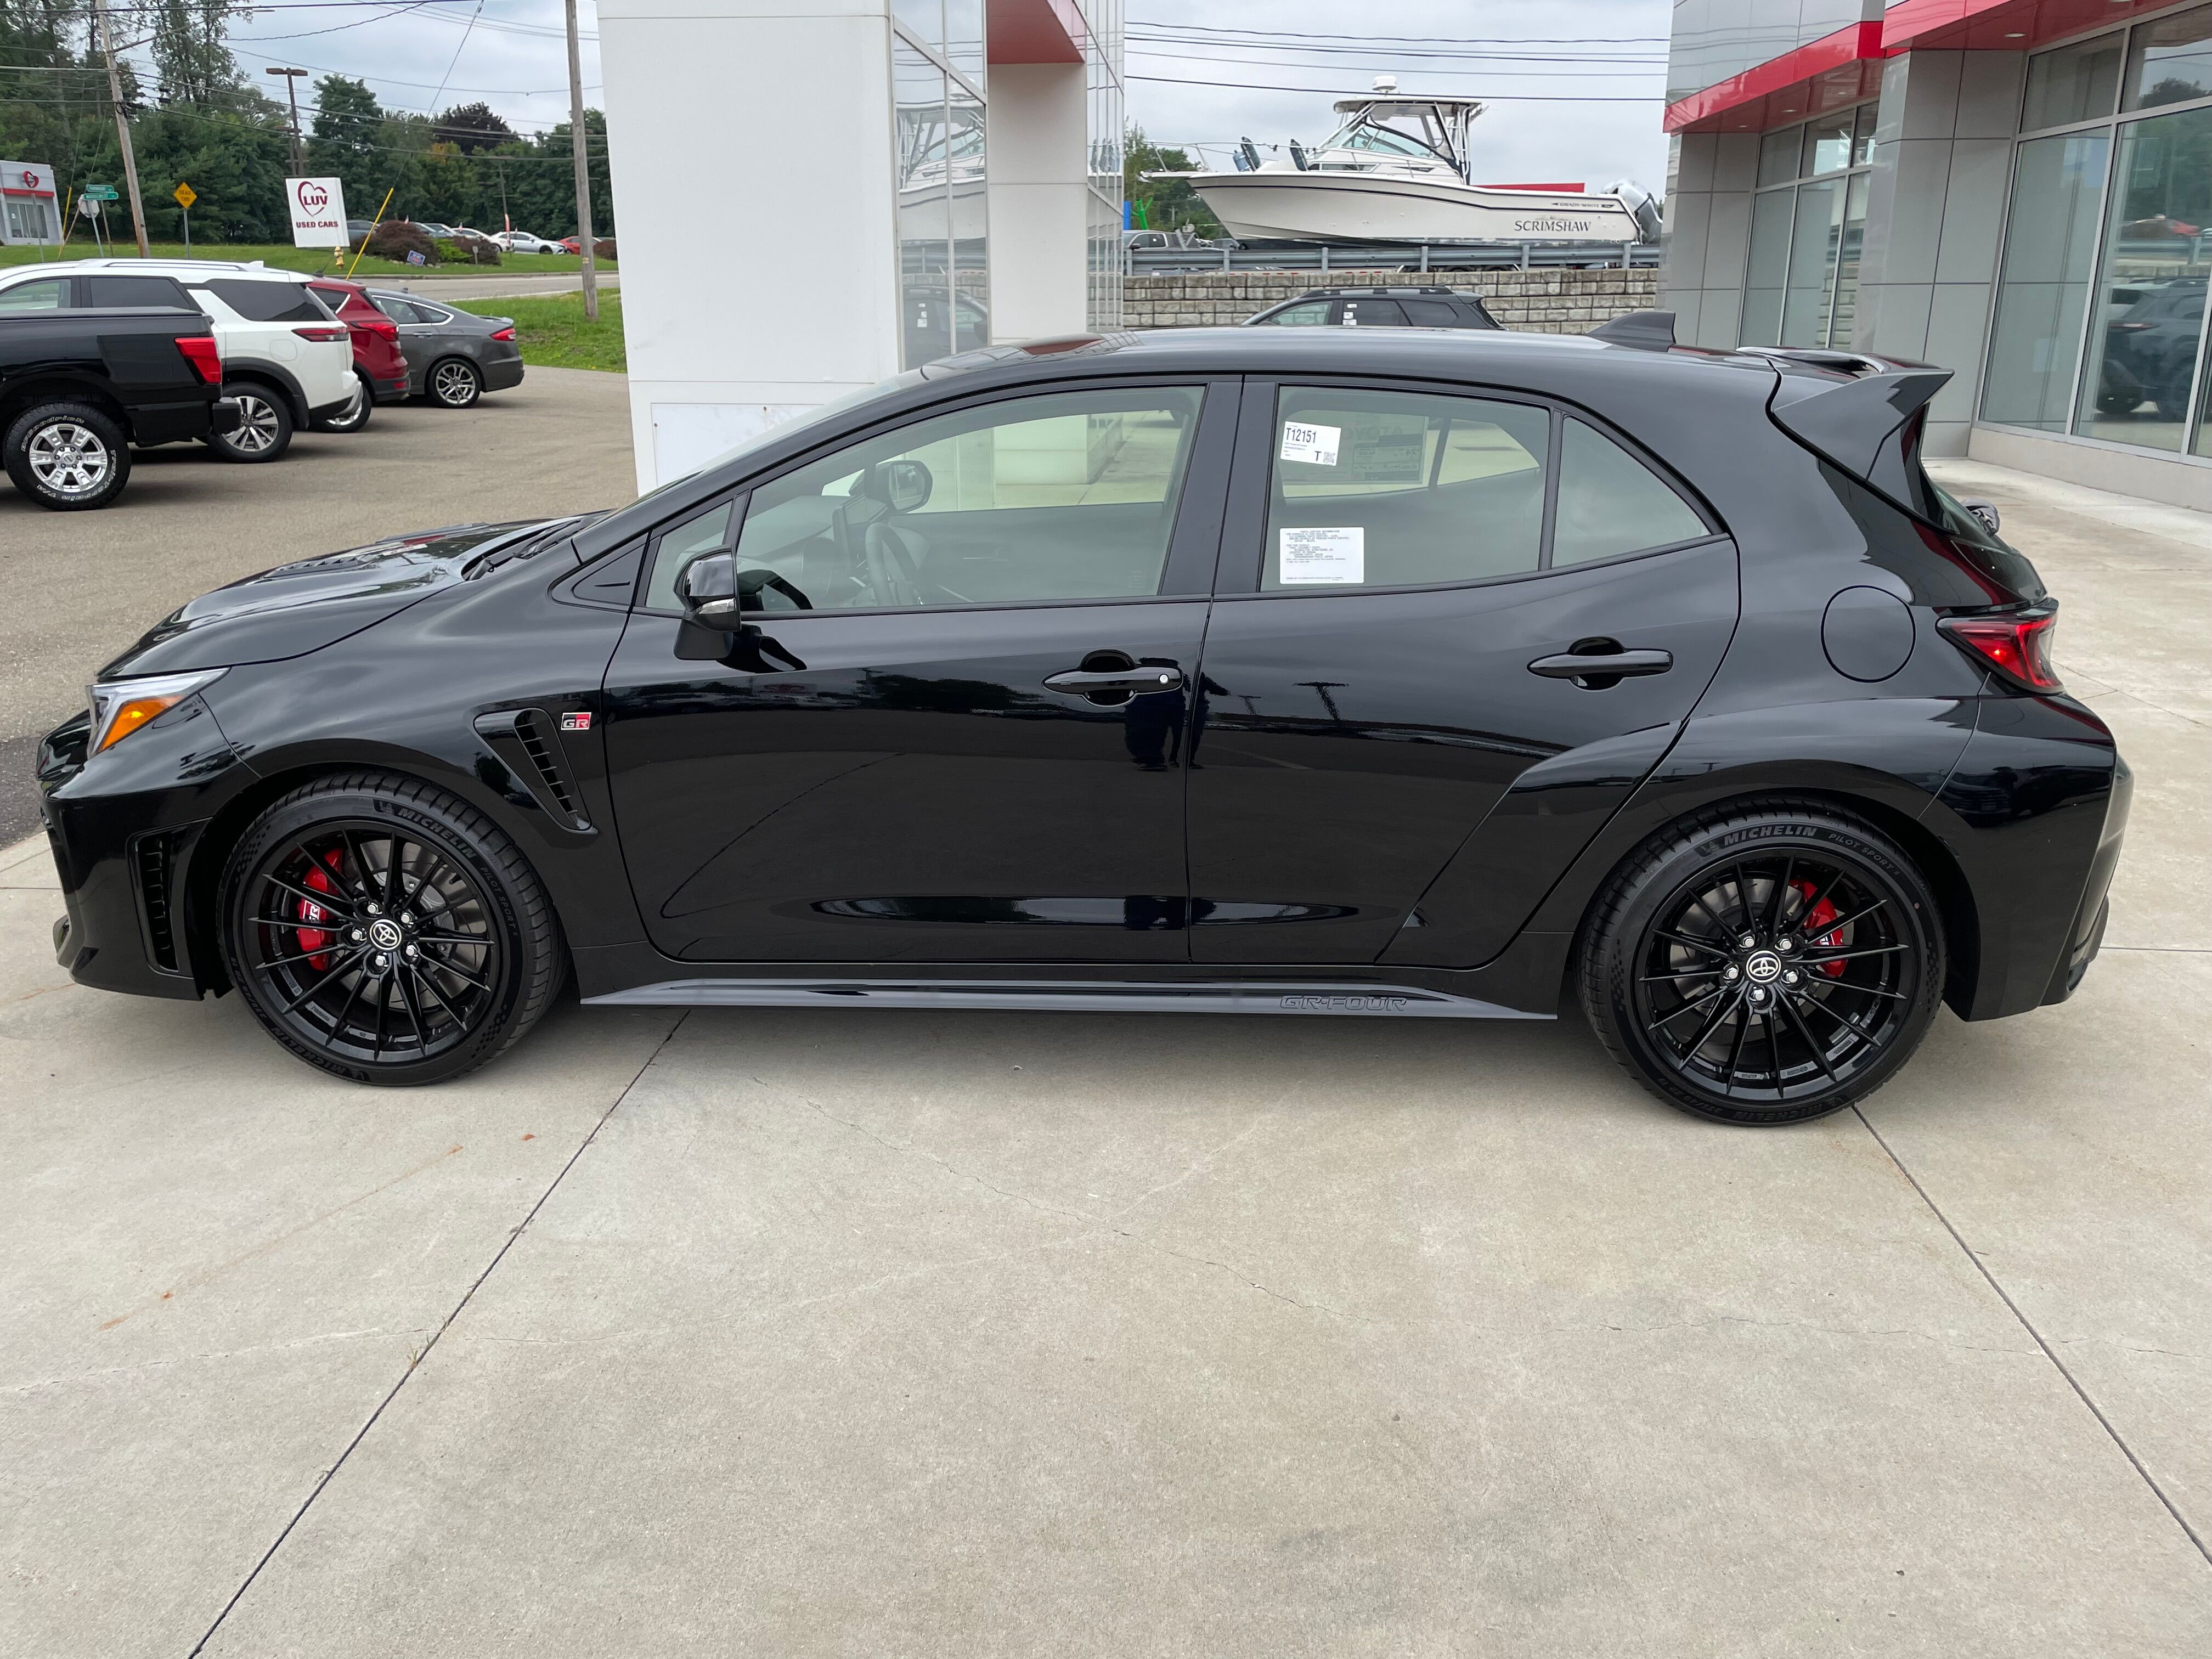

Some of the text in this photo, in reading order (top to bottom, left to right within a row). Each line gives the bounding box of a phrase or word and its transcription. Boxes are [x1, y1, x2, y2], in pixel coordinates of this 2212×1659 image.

[303, 195, 328, 205] LUV
[1514, 221, 1592, 232] SCRIMSHAW
[1286, 427, 1317, 444] T12151
[1314, 450, 1322, 461] T
[563, 719, 589, 729] GR
[1724, 825, 1818, 847] MICHELIN
[1828, 833, 1861, 849] PILOT
[1861, 847, 1895, 870] SPORT
[398, 808, 477, 859] MICHELIN
[481, 867, 502, 893] PILOT
[499, 896, 517, 928] SPORT
[1280, 995, 1407, 1011] GR-FOUR
[270, 1027, 346, 1074] MICHELIN
[1733, 1103, 1824, 1121] MICHELIN
